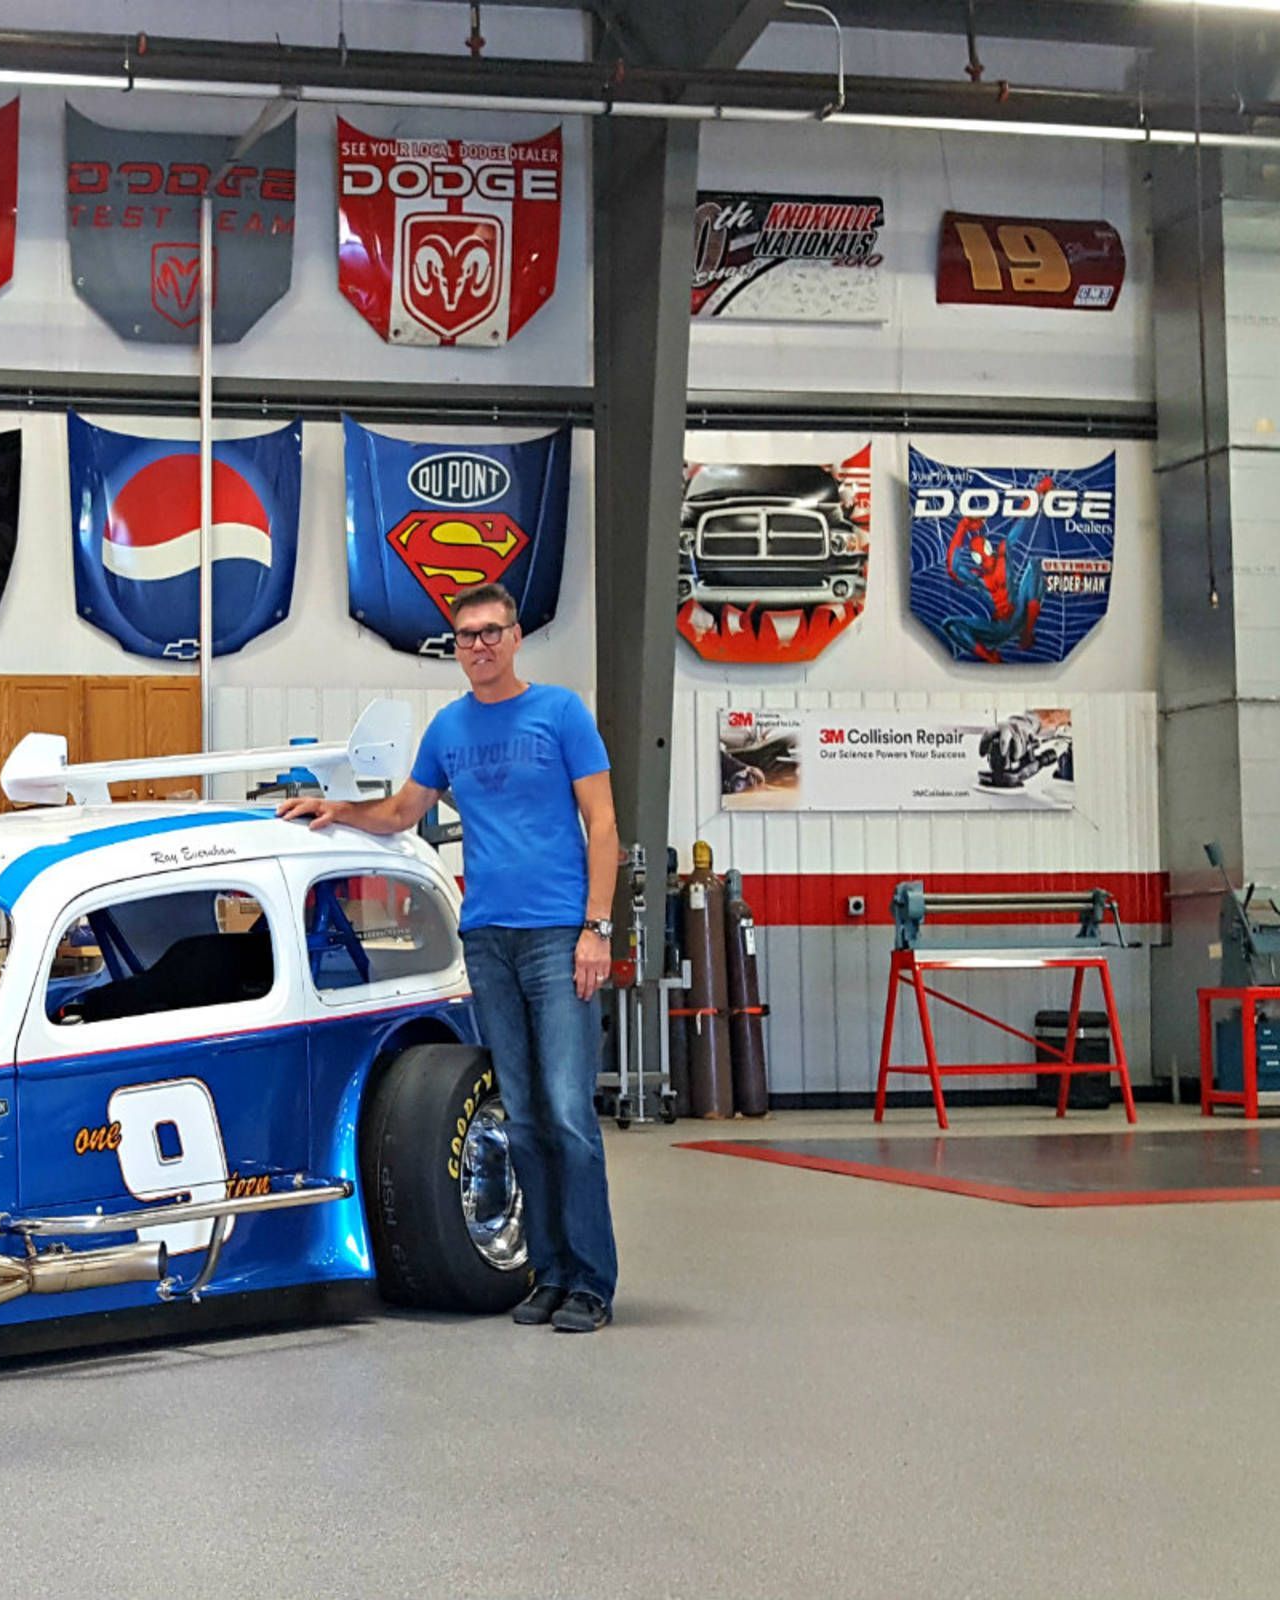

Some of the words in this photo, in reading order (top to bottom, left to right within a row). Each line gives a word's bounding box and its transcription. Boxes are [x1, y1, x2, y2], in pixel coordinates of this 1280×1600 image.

[341, 142, 367, 156] SEE
[371, 142, 411, 157] YOUR
[413, 143, 453, 159] LOCAL
[460, 143, 506, 160] DODGE
[509, 146, 559, 162] DEALER
[343, 161, 558, 201] DODGE
[70, 205, 172, 230] TEST
[764, 202, 881, 232] KNOXVILLE
[753, 230, 878, 260] NATIONALS
[954, 222, 1071, 292] 19
[914, 489, 1113, 520] DODGE
[1065, 519, 1113, 535] Dealers
[1042, 561, 1111, 572] ULTIMATE
[1046, 574, 1106, 593] SPIDER-MAN
[728, 712, 753, 728] 3M
[819, 729, 845, 745] 3M
[847, 728, 913, 745] Collision
[916, 728, 965, 749] Repair
[819, 749, 837, 759] Our
[838, 749, 874, 759] Science
[875, 749, 908, 759] Powers
[909, 749, 929, 759] Your
[930, 749, 966, 759] Success
[150, 850, 179, 864] Ray
[74, 1120, 121, 1156] one
[107, 1076, 236, 1257] 9
